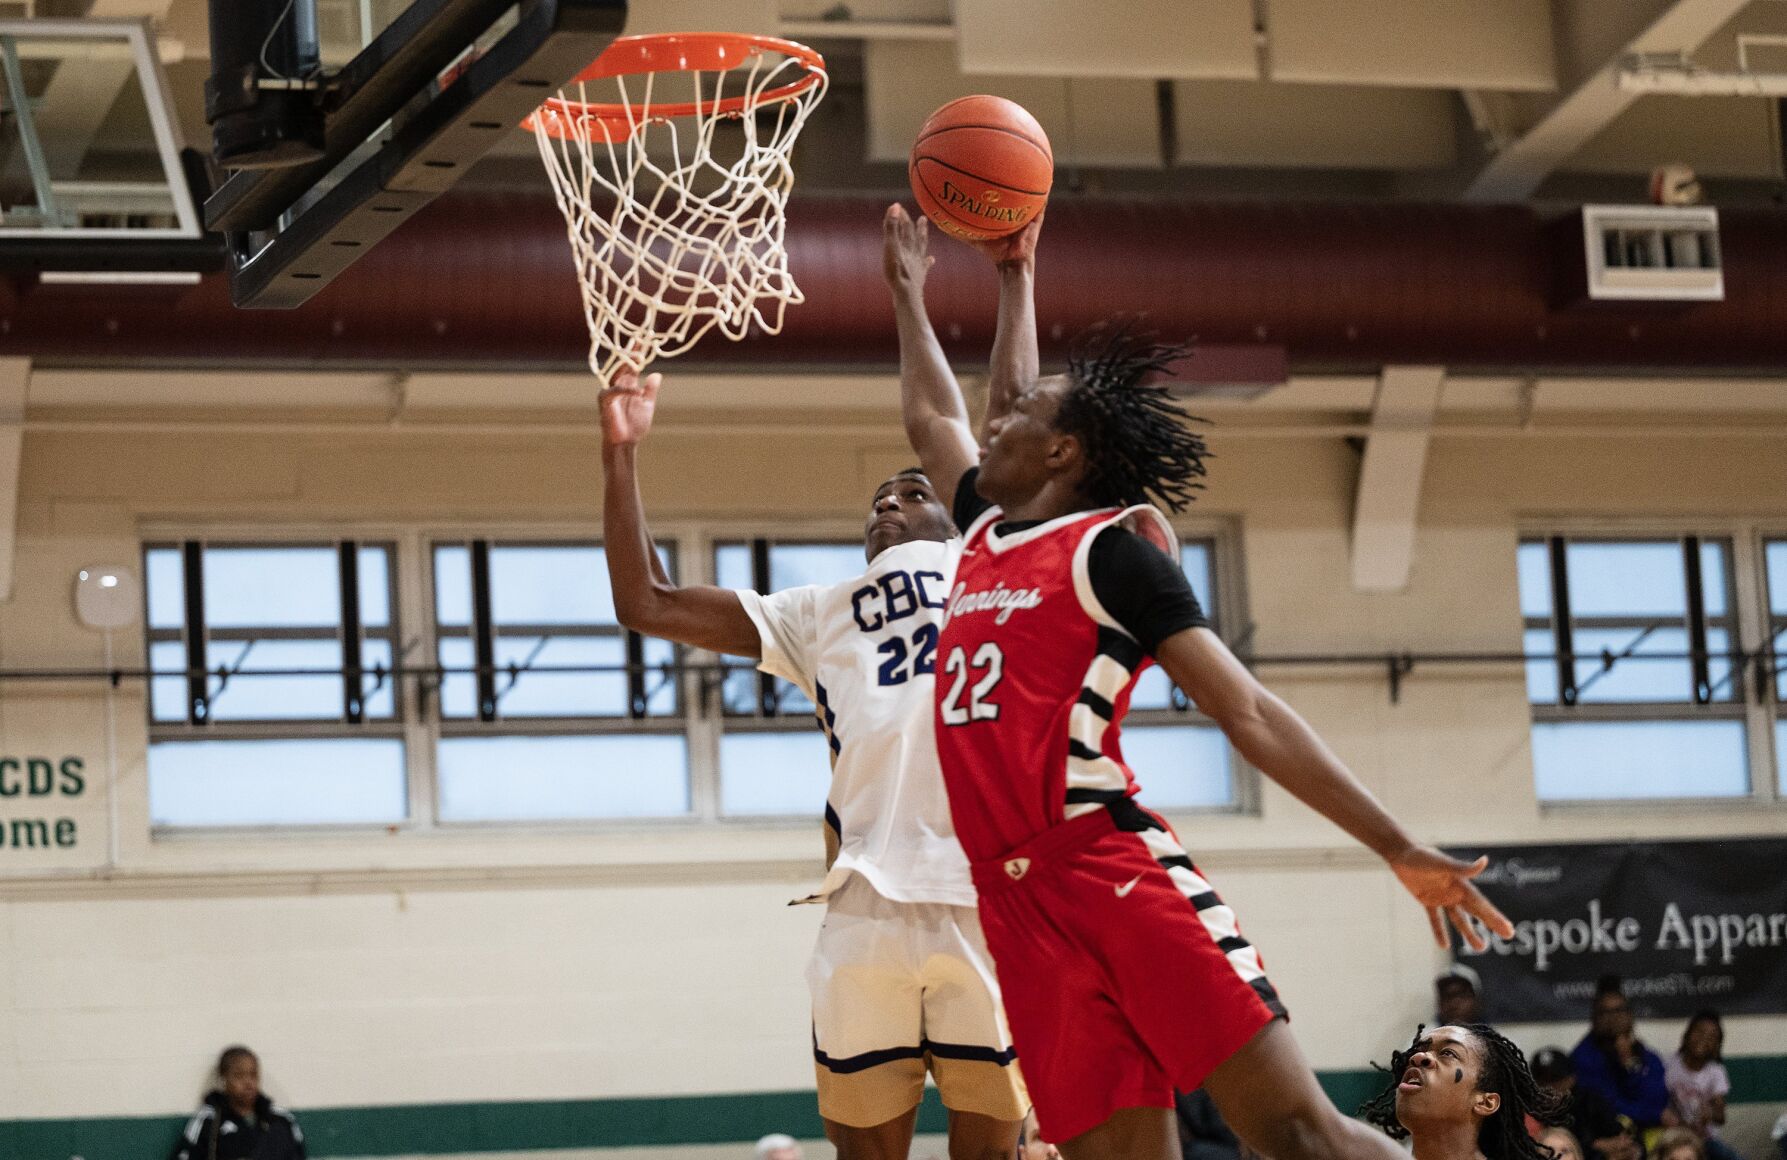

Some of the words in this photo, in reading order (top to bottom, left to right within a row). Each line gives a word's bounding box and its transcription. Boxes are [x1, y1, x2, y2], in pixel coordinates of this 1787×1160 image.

[938, 180, 1029, 222] SPALDING
[851, 569, 945, 632] CBC
[877, 622, 940, 687] 22
[940, 640, 1004, 726] 22
[1655, 901, 1787, 966] Appar
